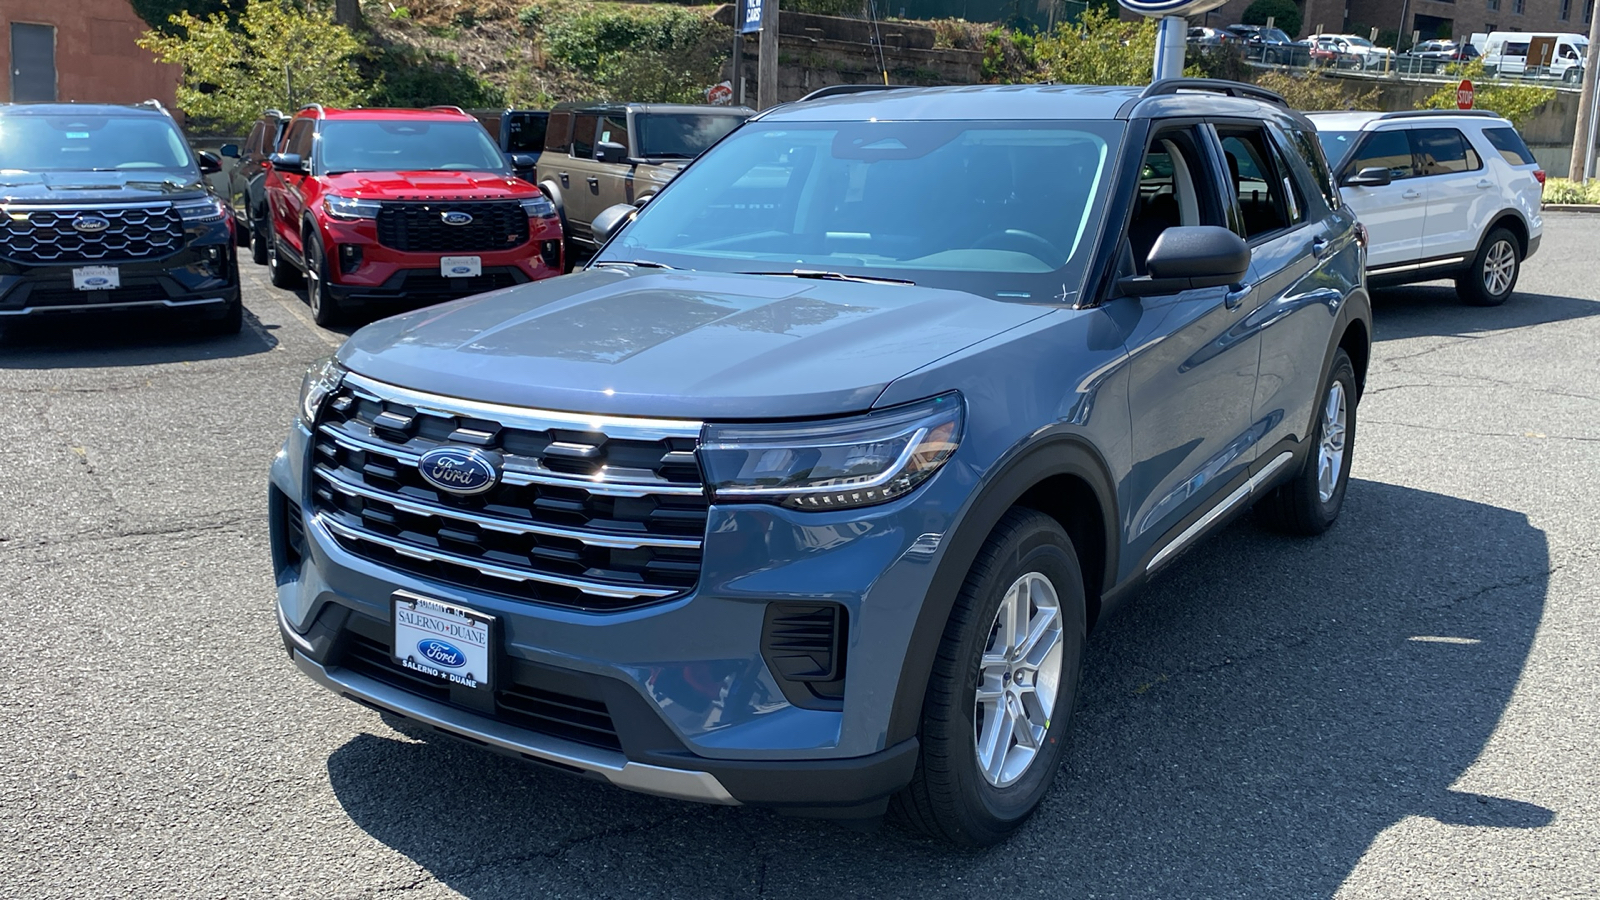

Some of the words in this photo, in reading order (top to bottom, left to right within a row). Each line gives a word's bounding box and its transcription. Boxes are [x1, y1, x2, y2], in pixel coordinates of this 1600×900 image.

[746, 7, 761, 23] CARS
[1458, 90, 1473, 104] STOP
[433, 456, 475, 484] Ford
[398, 611, 445, 633] SALERNO
[450, 624, 486, 645] DUANE
[426, 641, 457, 665] Ford
[402, 659, 439, 677] SALERNO
[449, 673, 477, 689] DUANE
